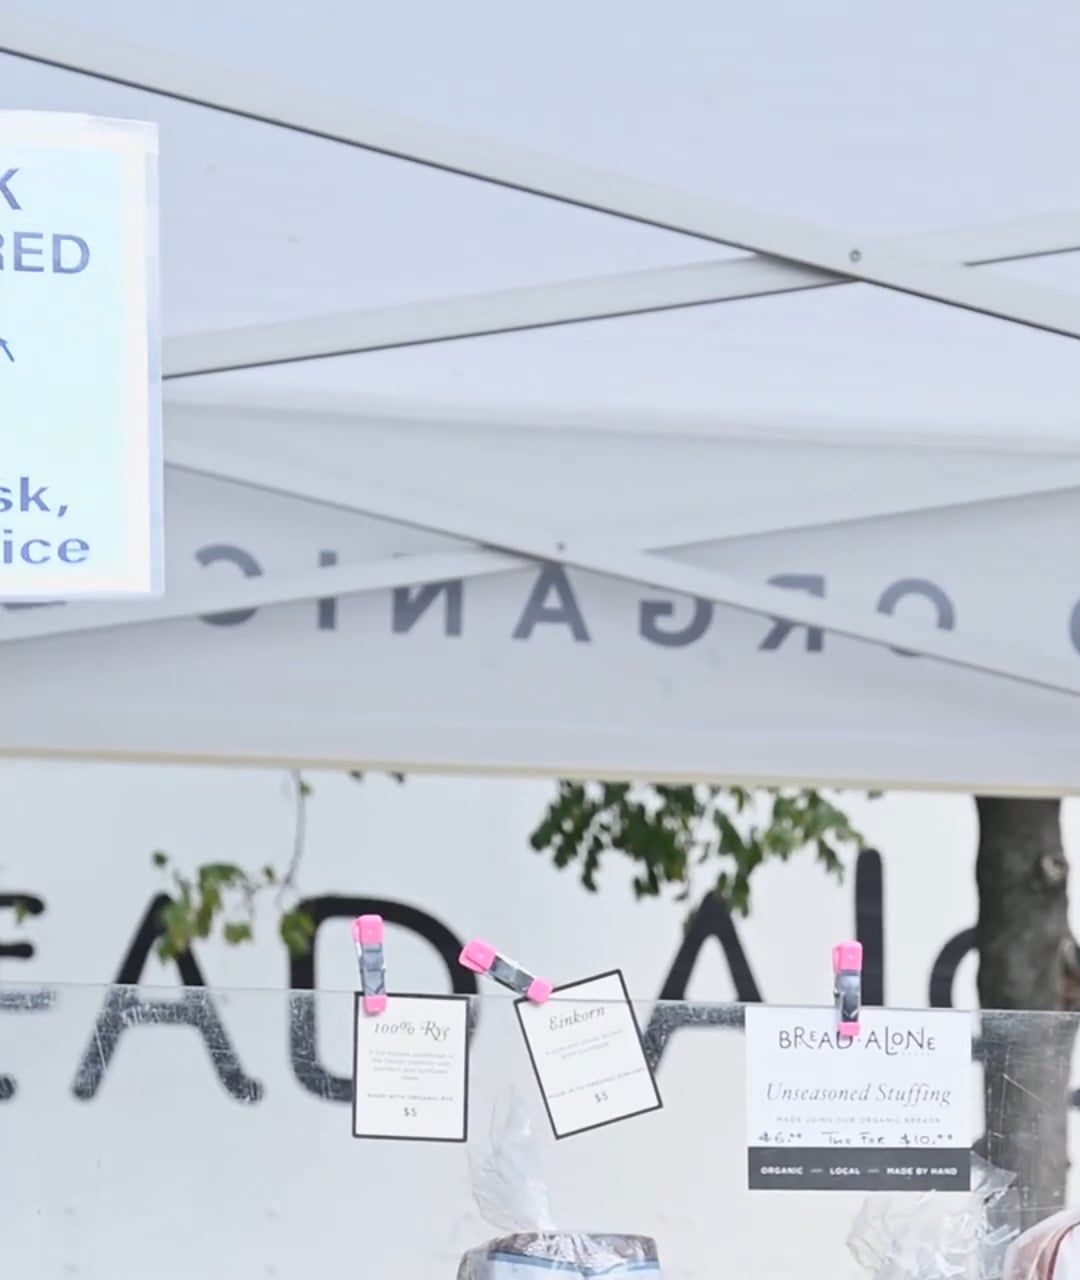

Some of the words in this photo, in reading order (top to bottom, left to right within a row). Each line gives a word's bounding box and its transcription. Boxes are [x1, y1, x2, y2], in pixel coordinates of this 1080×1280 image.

[549, 1005, 606, 1031] Einkorn
[373, 1022, 416, 1035] 100%
[778, 1026, 853, 1050] BREAD
[864, 1026, 936, 1056] ALONE
[594, 1090, 609, 1104] $5
[766, 1082, 871, 1102] Unseasoned
[874, 1082, 952, 1107] Stuffing
[403, 1106, 418, 1118] $5
[760, 1166, 803, 1176] ORGANIC
[829, 1166, 861, 1176] LOCAL
[886, 1166, 913, 1176] MADE
[915, 1166, 929, 1176] BY
[930, 1166, 958, 1176] HAND
